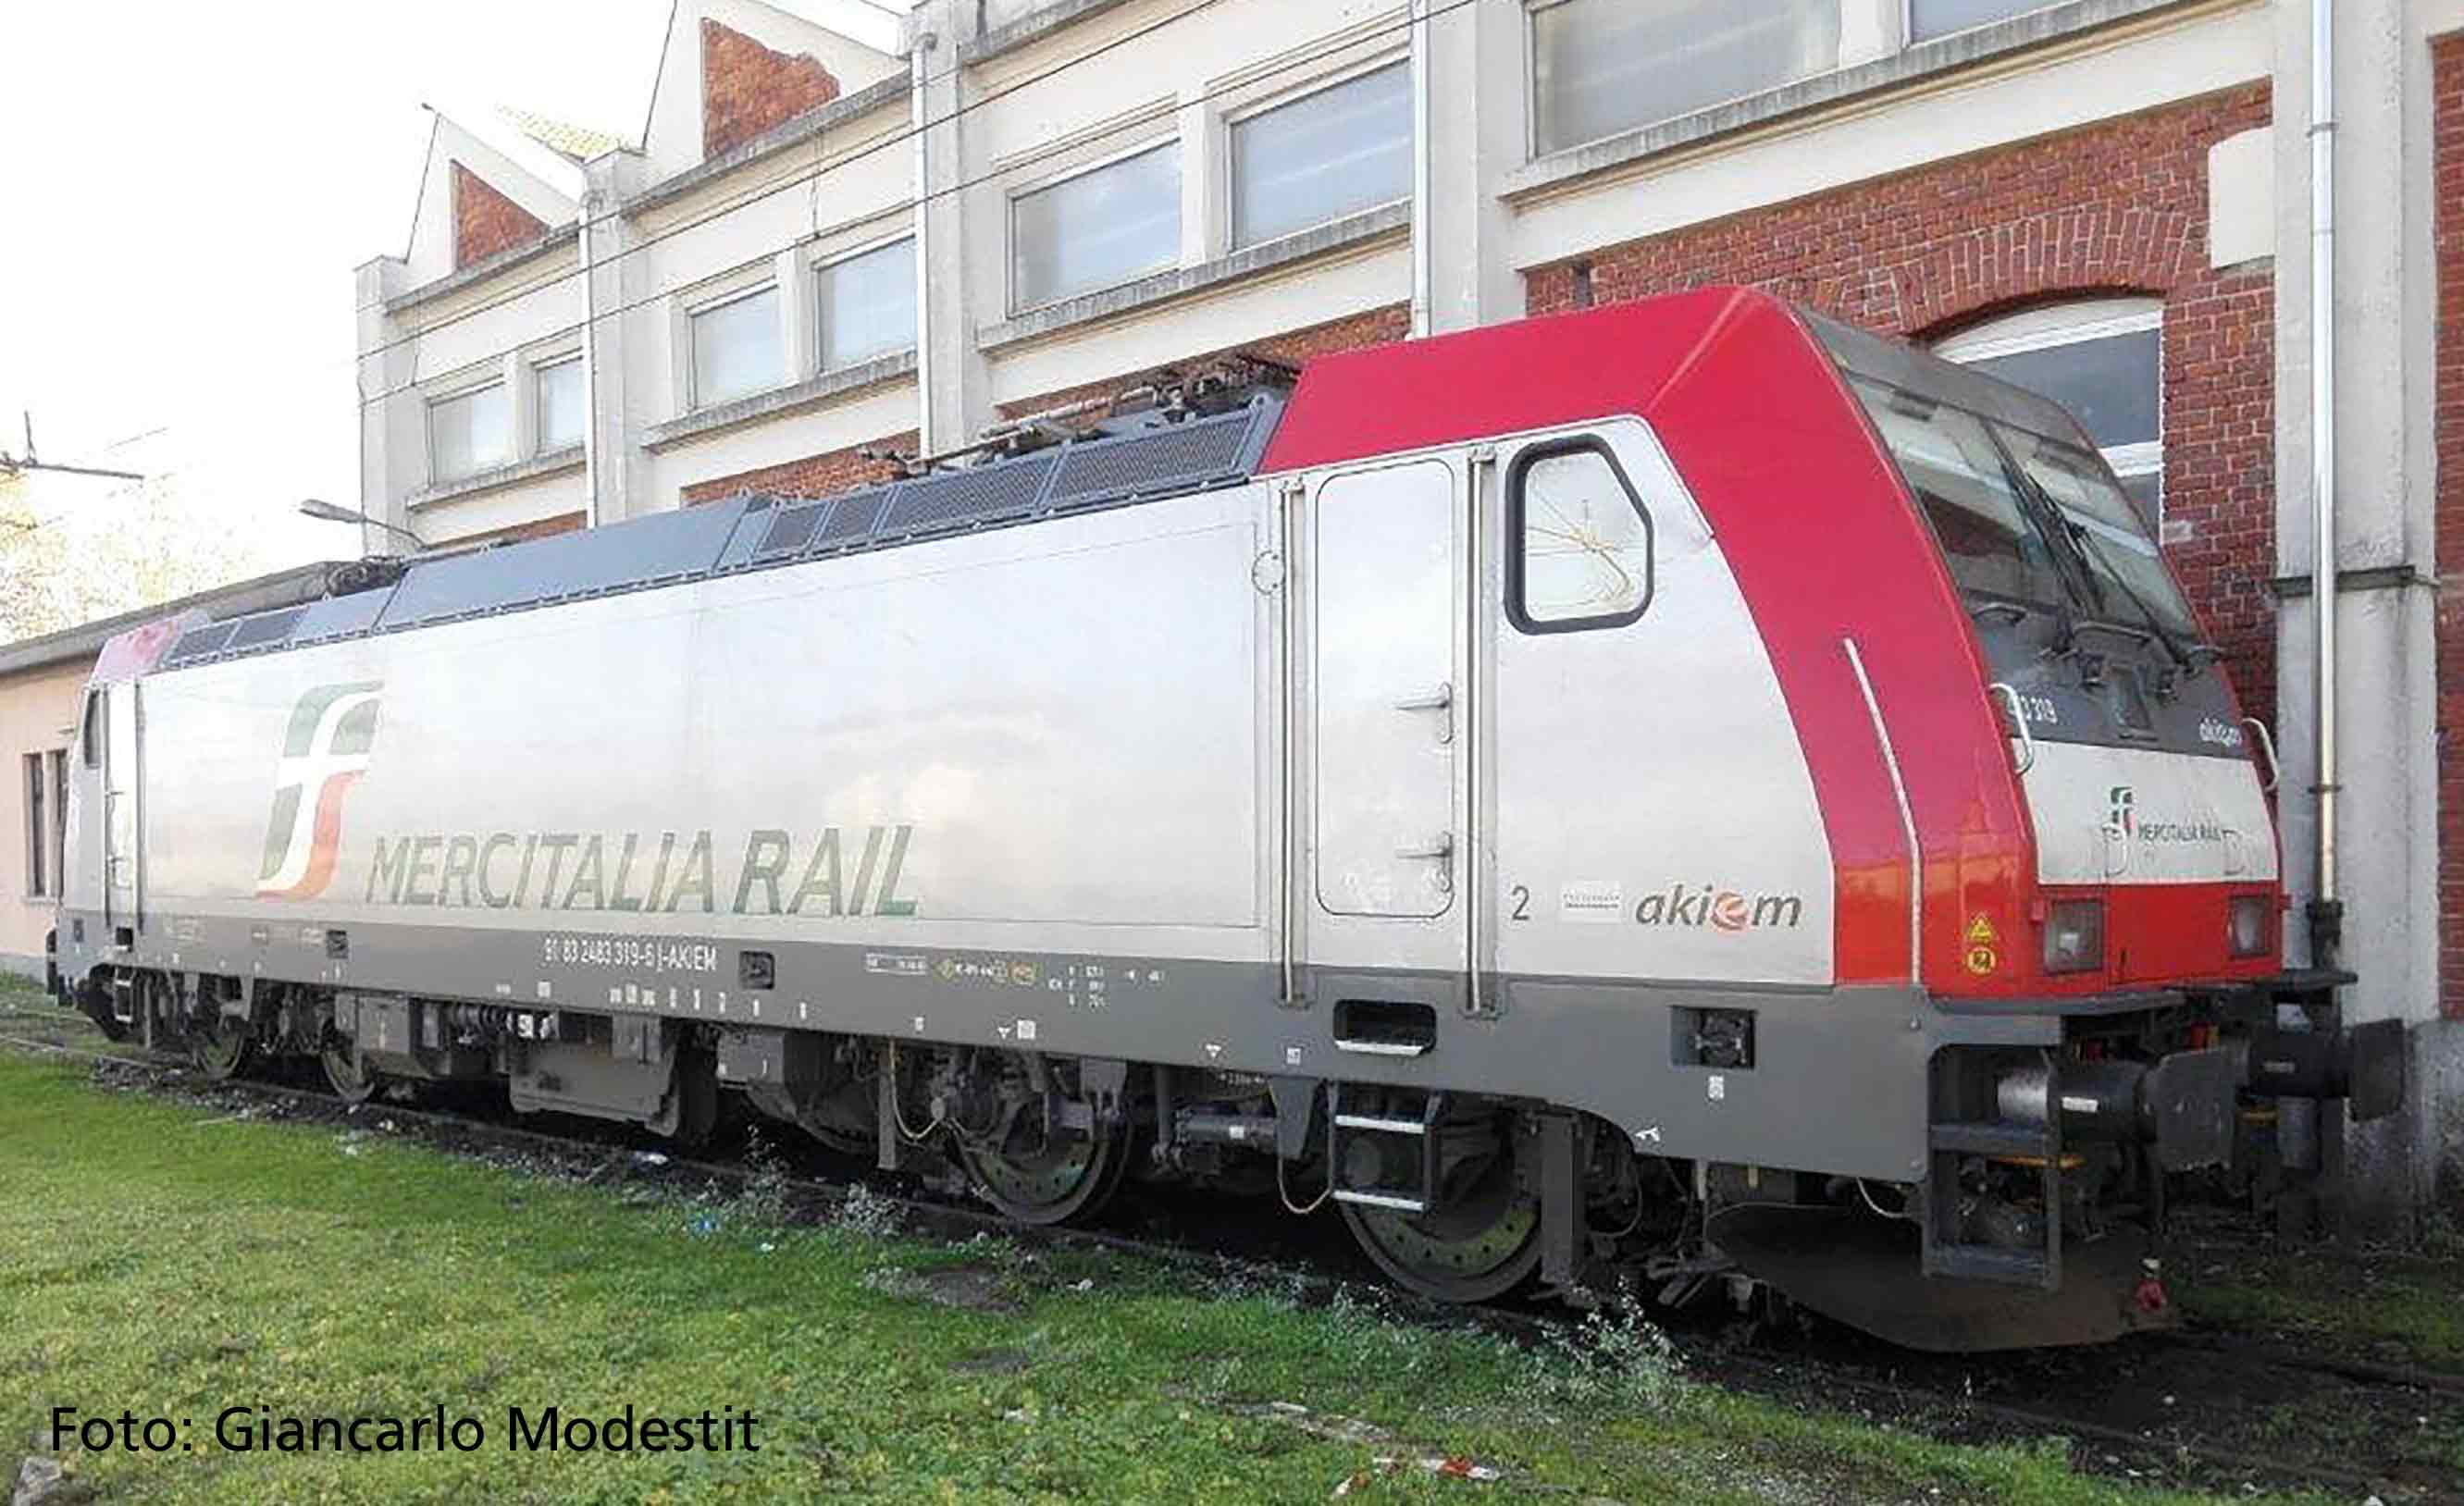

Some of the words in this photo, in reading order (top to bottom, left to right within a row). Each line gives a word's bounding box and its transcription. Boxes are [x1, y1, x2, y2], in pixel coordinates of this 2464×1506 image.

[365, 831, 713, 915] MERCITALIA
[734, 824, 918, 917] RAIL
[1511, 884, 1531, 921] 2
[1635, 883, 1802, 931] akiem
